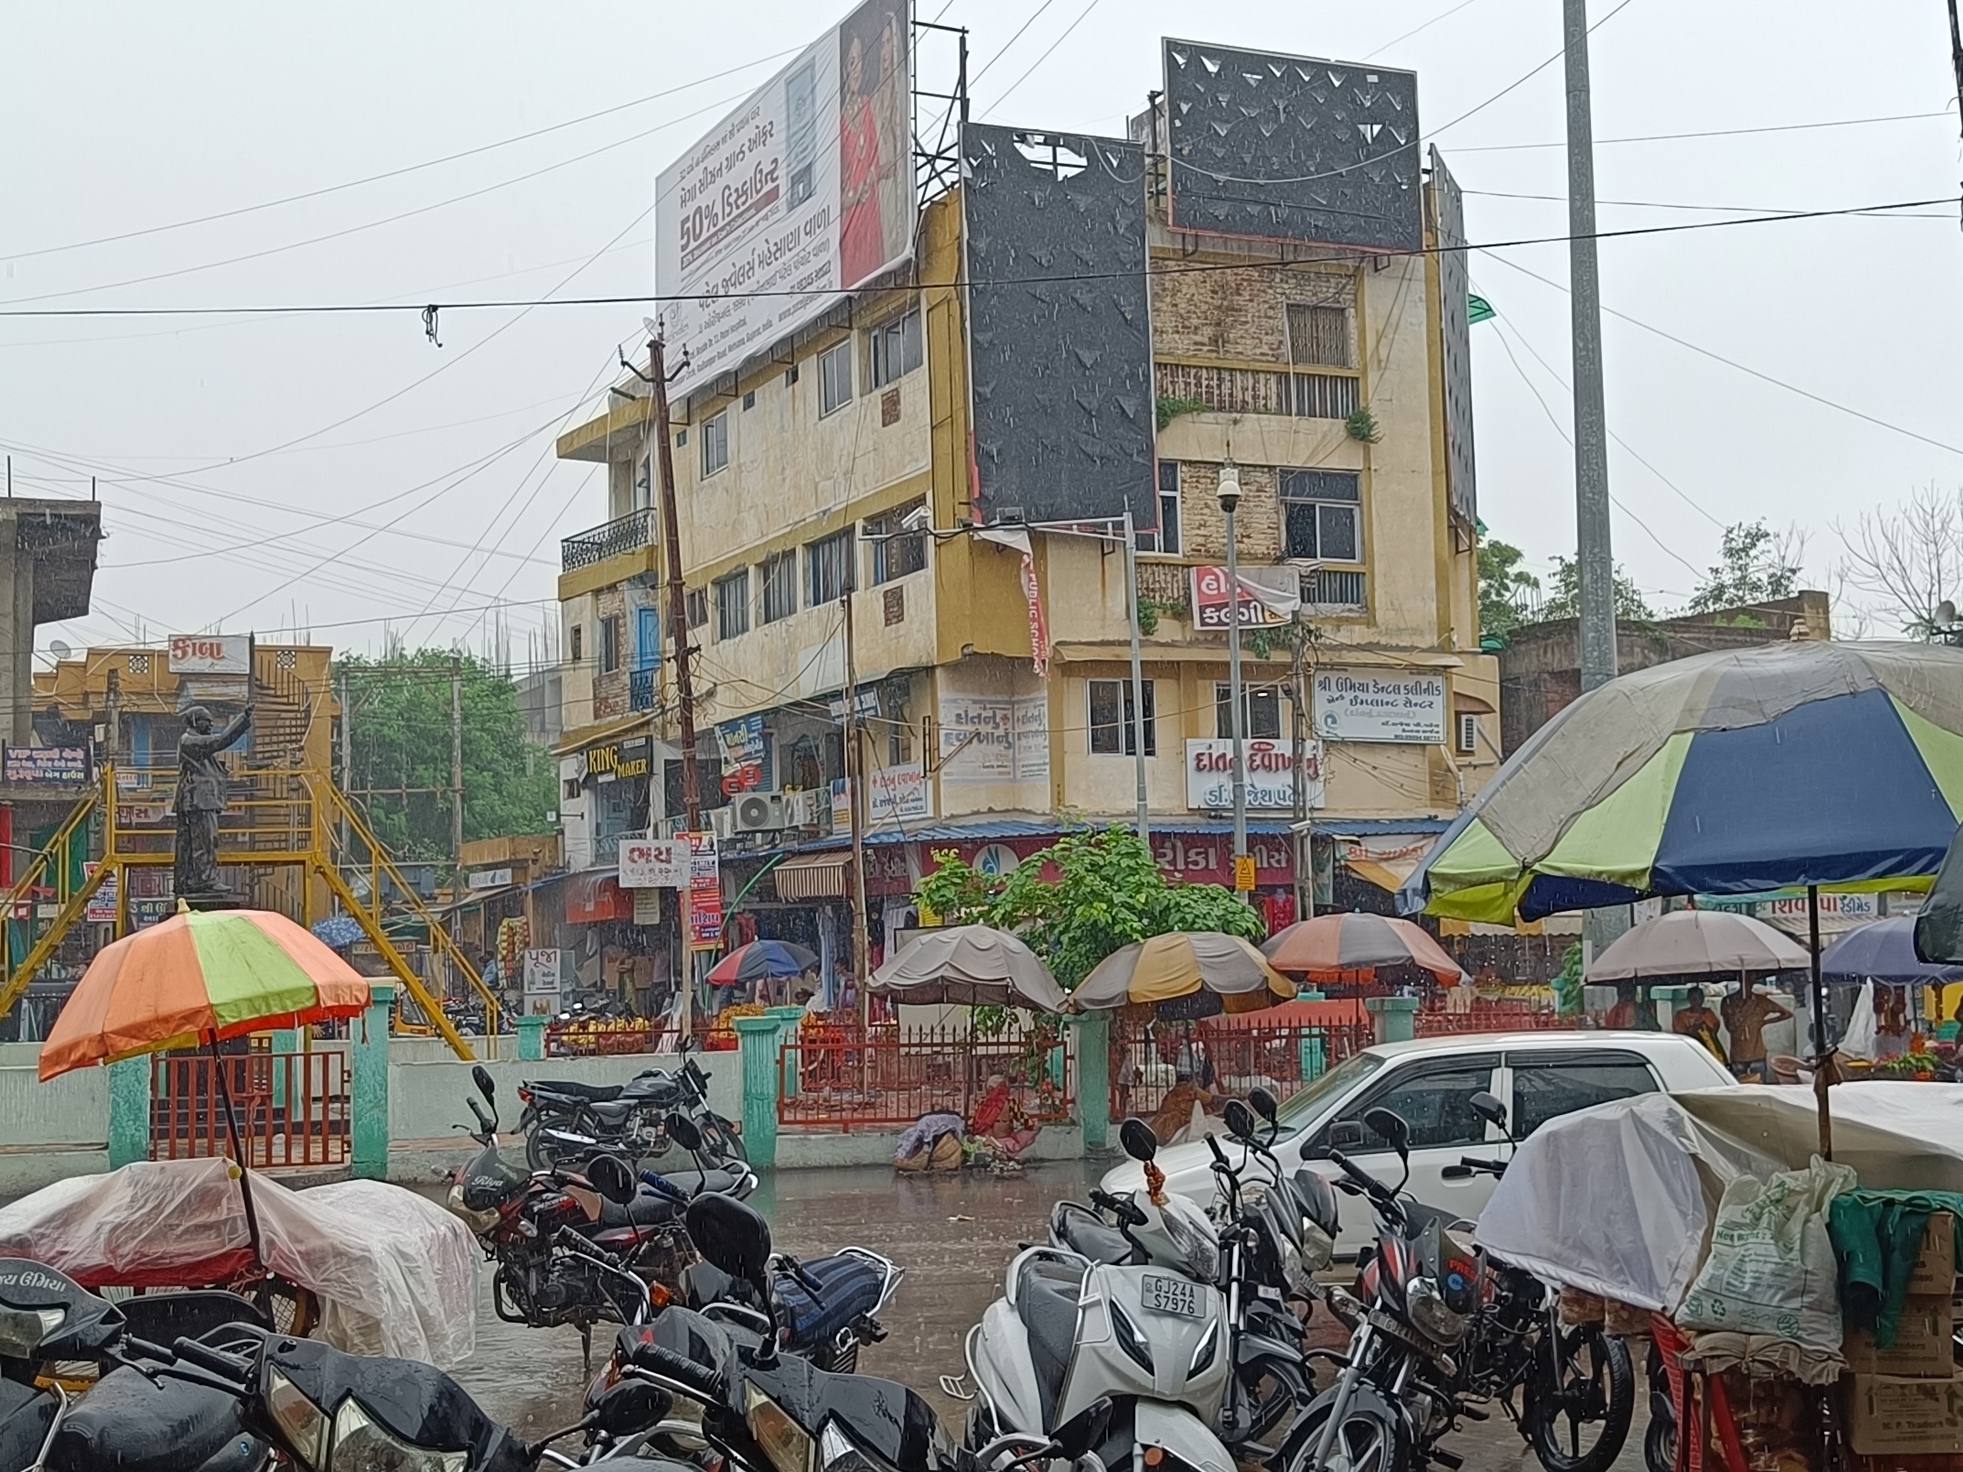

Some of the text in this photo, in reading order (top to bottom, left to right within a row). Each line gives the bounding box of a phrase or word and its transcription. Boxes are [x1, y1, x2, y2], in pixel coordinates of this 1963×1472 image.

[680, 183, 696, 209] મેગા
[748, 121, 774, 153] ઓફર
[680, 199, 718, 252] 50%
[721, 157, 779, 221] ડિસ્કાઉન્ટ
[699, 281, 719, 311] પટેલ
[757, 227, 800, 270] મહેસાણા
[804, 204, 830, 238] વાળા
[1317, 676, 1442, 697] શ્રી ઉમિયા ડેન્ટલ કલીનીક
[589, 745, 618, 774] KING
[617, 758, 648, 778] MAKER
[527, 950, 557, 968] પૂજા
[0, 1271, 67, 1292] ય ઉમિયા
[1155, 1279, 1195, 1299] GJ24A
[1154, 1293, 1195, 1314] S7976
